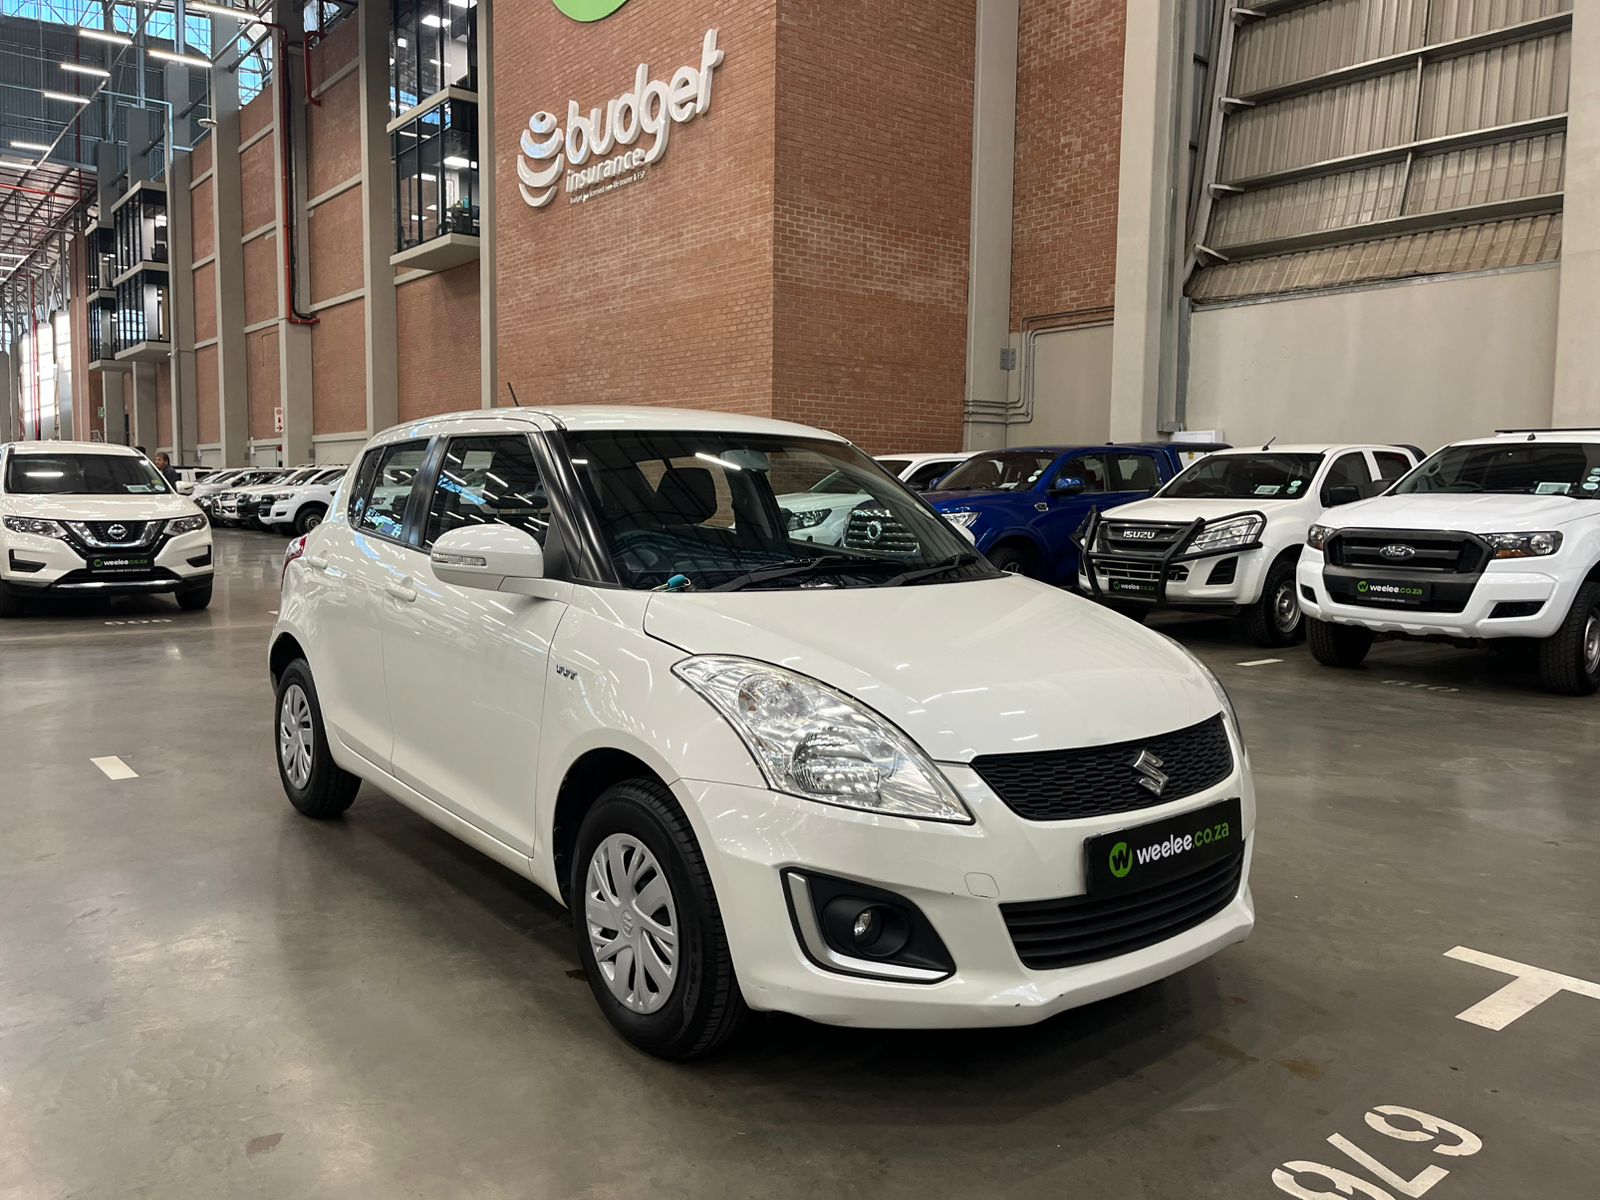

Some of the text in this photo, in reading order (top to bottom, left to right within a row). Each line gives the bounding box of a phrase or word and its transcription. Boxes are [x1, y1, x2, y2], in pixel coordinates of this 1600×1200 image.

[565, 28, 725, 165] budget
[565, 148, 646, 193] insurance
[1123, 530, 1155, 539] ISUZU
[1369, 584, 1423, 595] weelee.co.za
[1137, 822, 1229, 864] weelee.co.za
